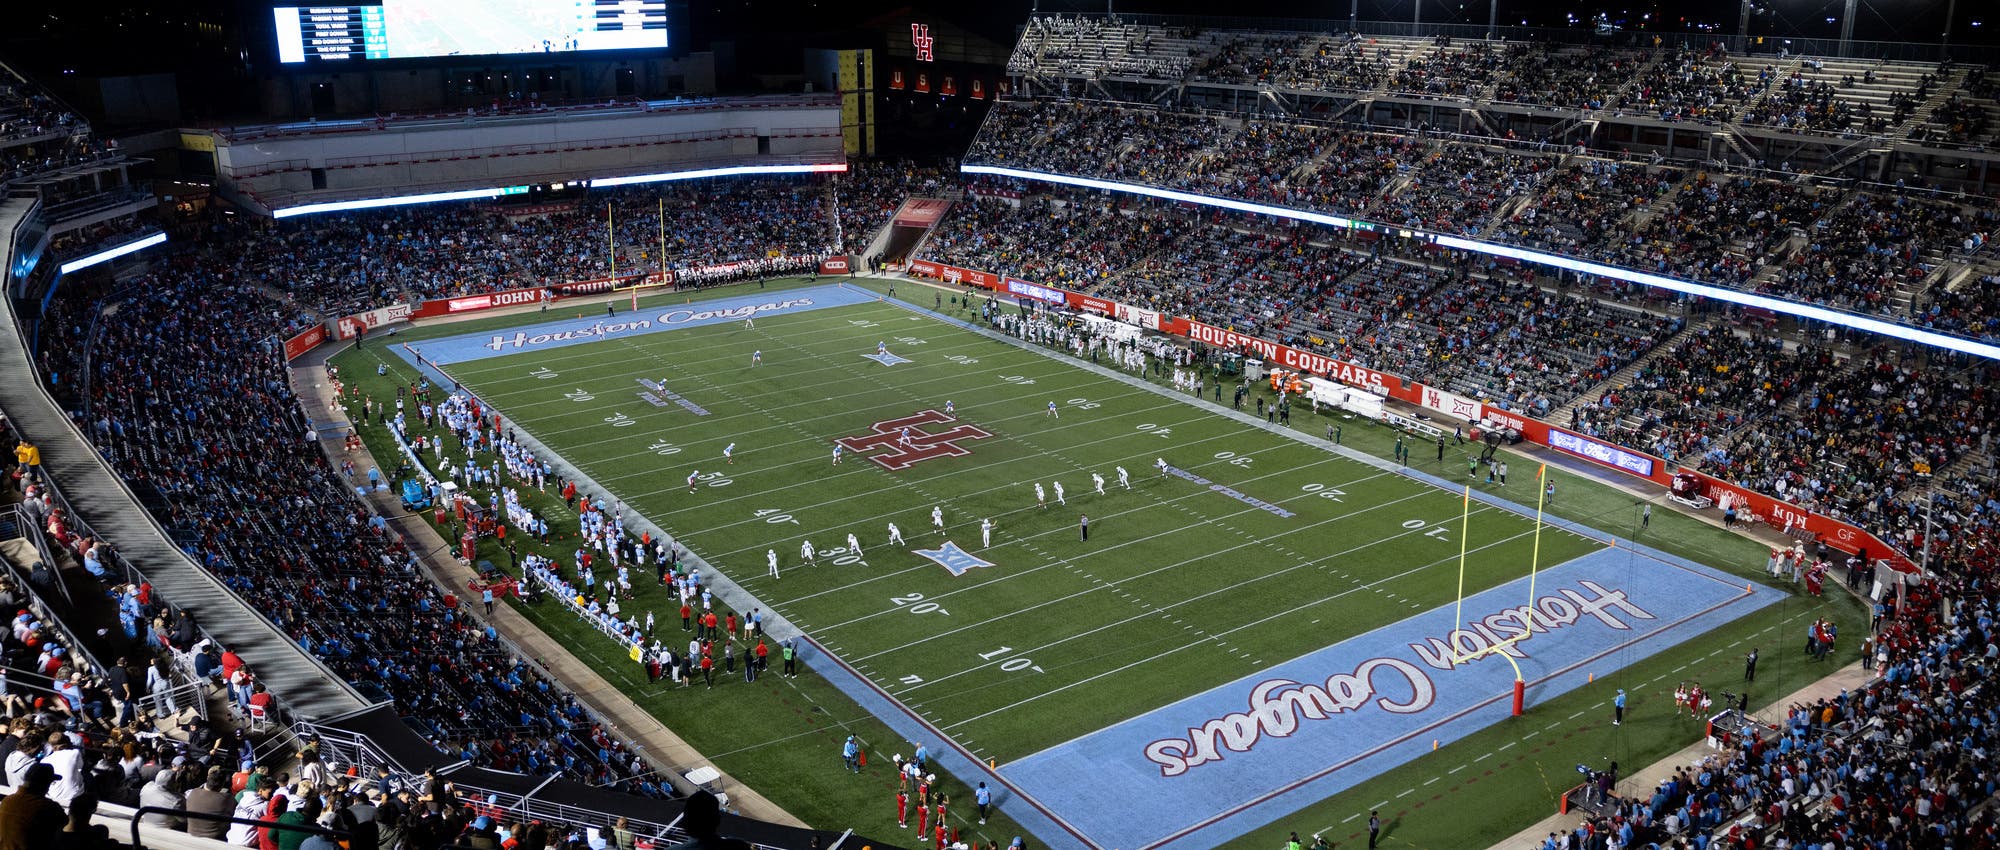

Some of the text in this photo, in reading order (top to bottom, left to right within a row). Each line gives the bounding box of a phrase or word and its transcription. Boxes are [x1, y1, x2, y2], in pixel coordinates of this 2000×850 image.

[912, 23, 933, 62] UH
[492, 290, 535, 306] JOHN
[365, 311, 378, 326] UH
[485, 297, 815, 350] Houston Cougars
[339, 319, 355, 337] UH
[1190, 323, 1383, 387] HOUSTON COUGARS
[564, 390, 595, 402] 20
[1428, 390, 1440, 408] UH
[604, 414, 636, 427] 30
[1488, 411, 1524, 431] COUGAR PRIDE
[1136, 423, 1172, 437] 40
[647, 443, 681, 455] 40
[1584, 442, 1612, 461] Ford
[1214, 451, 1252, 466] 30
[698, 471, 734, 487] 50
[1301, 483, 1347, 500] 20
[1710, 485, 1749, 505] MEMORIAL
[753, 508, 792, 524] 40
[1401, 518, 1449, 539] 10
[818, 547, 861, 566] 30
[890, 592, 940, 615] 20
[1409, 579, 1657, 670] Houston
[977, 645, 1033, 672] 10
[1143, 657, 1436, 777] Cougars
